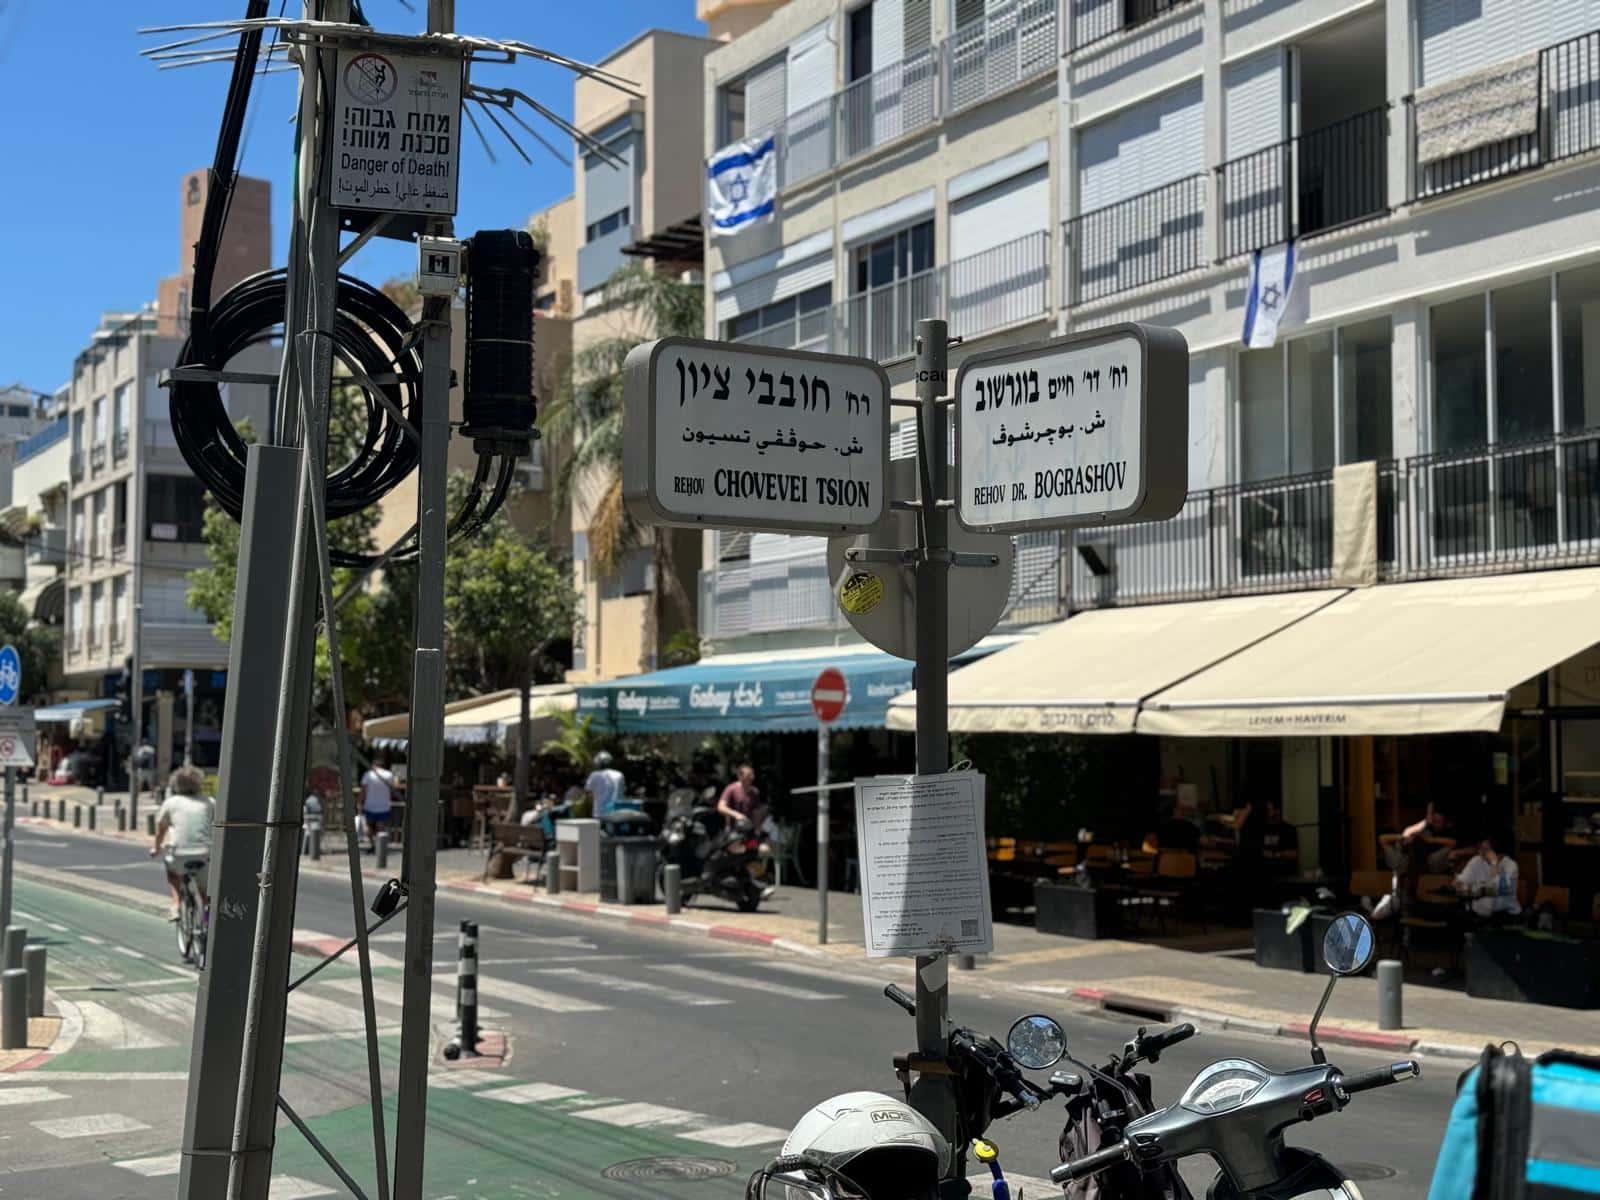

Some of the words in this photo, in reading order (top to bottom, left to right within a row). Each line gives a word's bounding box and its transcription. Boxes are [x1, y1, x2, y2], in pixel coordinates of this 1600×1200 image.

[344, 107, 396, 129] גבוה!
[408, 112, 450, 134] מתח
[342, 128, 390, 150] מוות!
[400, 133, 450, 155] סכנת
[341, 153, 388, 175] Danger
[391, 157, 405, 173] of
[408, 158, 450, 177] Death!
[676, 356, 731, 408] ציון
[745, 367, 831, 414] חובבי
[975, 367, 1041, 412] בוגרשוב
[1048, 373, 1075, 400] חיים
[682, 427, 751, 445] تسيون
[674, 475, 705, 497] REHOV
[714, 468, 808, 503] CHOVEVEI
[816, 477, 870, 508] TSION
[974, 484, 1006, 506] REHOV
[1012, 483, 1028, 501] DR.
[1034, 461, 1127, 499] BOGRASHOV
[1295, 713, 1347, 724] HAVERIM
